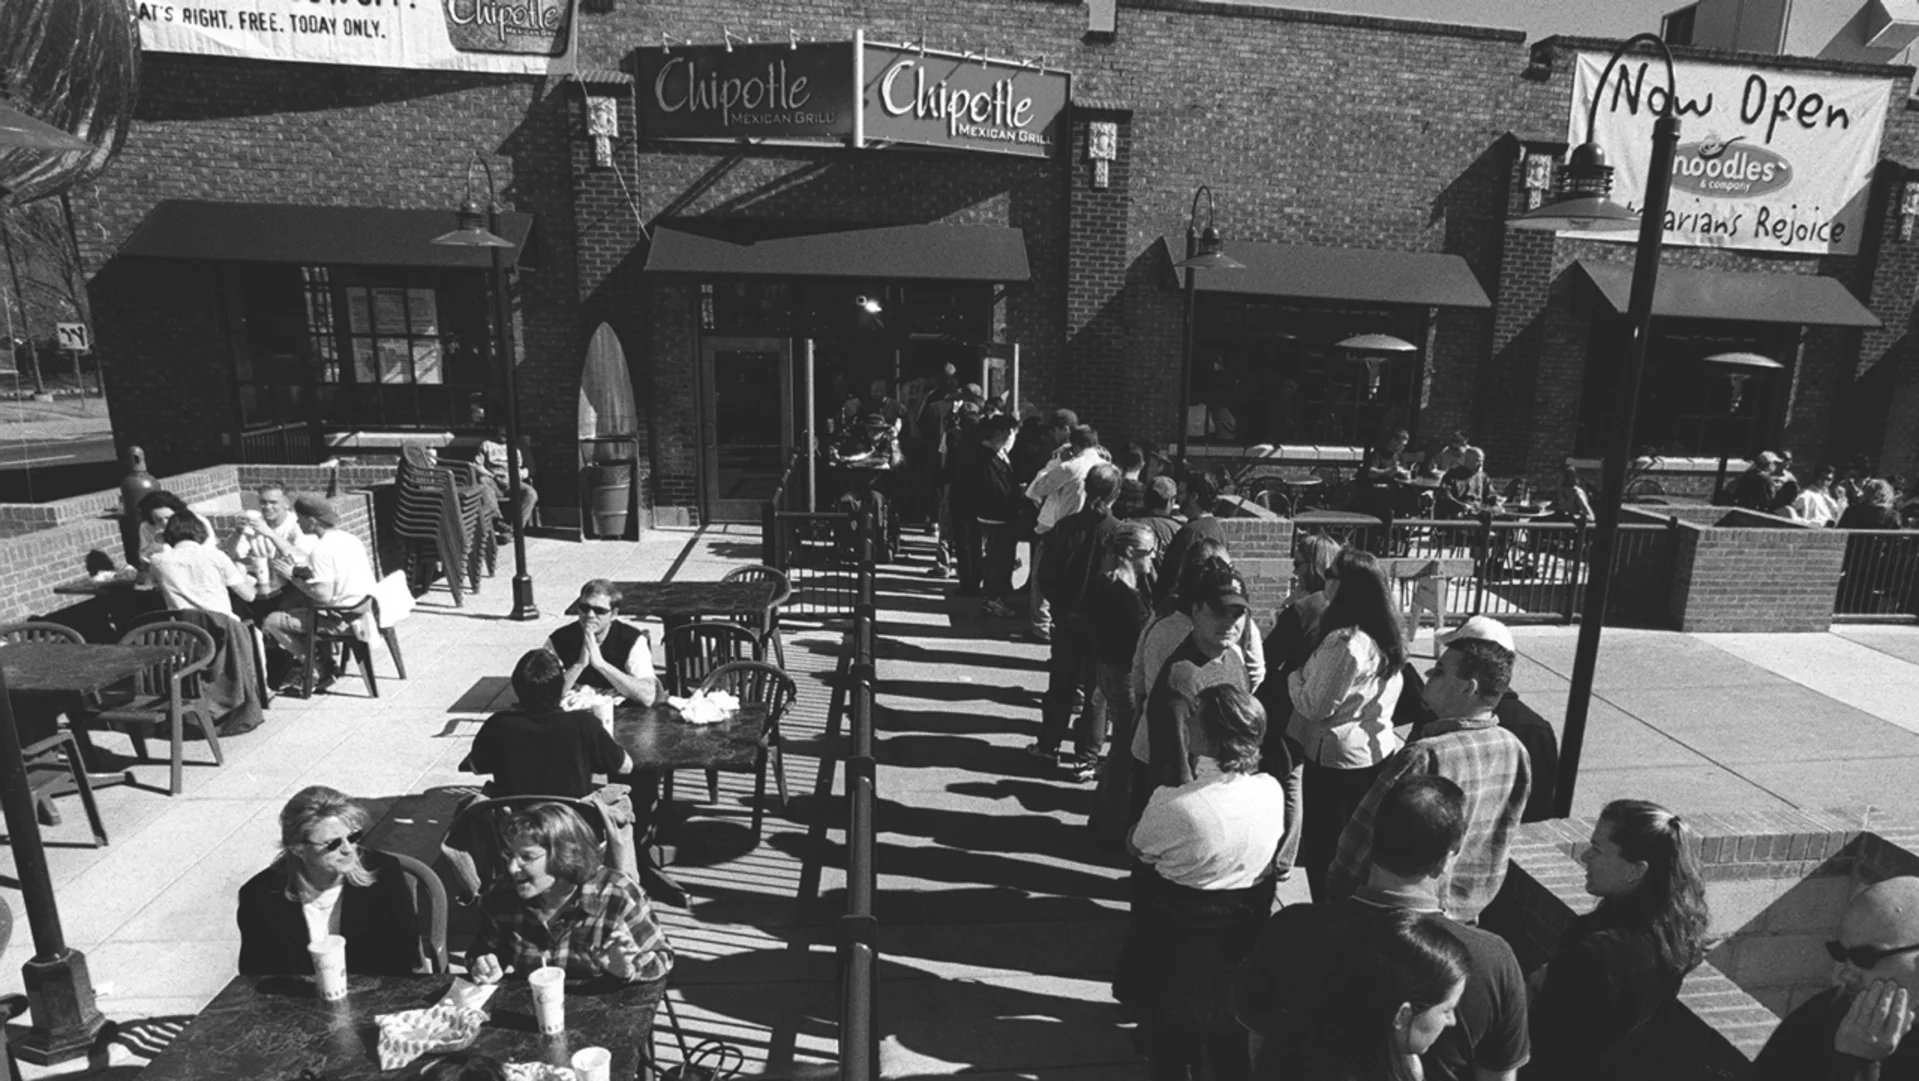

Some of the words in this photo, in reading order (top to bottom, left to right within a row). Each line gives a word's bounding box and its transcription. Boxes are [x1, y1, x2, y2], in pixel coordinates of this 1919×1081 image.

[138, 2, 173, 21] AT'S
[183, 8, 233, 30] RIGHT.
[239, 11, 284, 33] FREE.
[289, 14, 337, 36] TODAY
[343, 18, 386, 39] ONLY.
[448, 0, 559, 42] Chipotle
[655, 57, 811, 126] Chipotle
[882, 60, 1034, 136] Chipotle
[1610, 62, 1713, 117] Now
[1740, 74, 1850, 144] Open
[731, 112, 792, 124] MEXICAN
[795, 111, 835, 124] GRILL
[958, 122, 1017, 142] MEXICAN
[1018, 129, 1053, 145] GRILL
[1671, 151, 1777, 182] noodles
[1699, 179, 1706, 189] &
[1708, 180, 1753, 193] company
[1754, 203, 1846, 246] Rejoice
